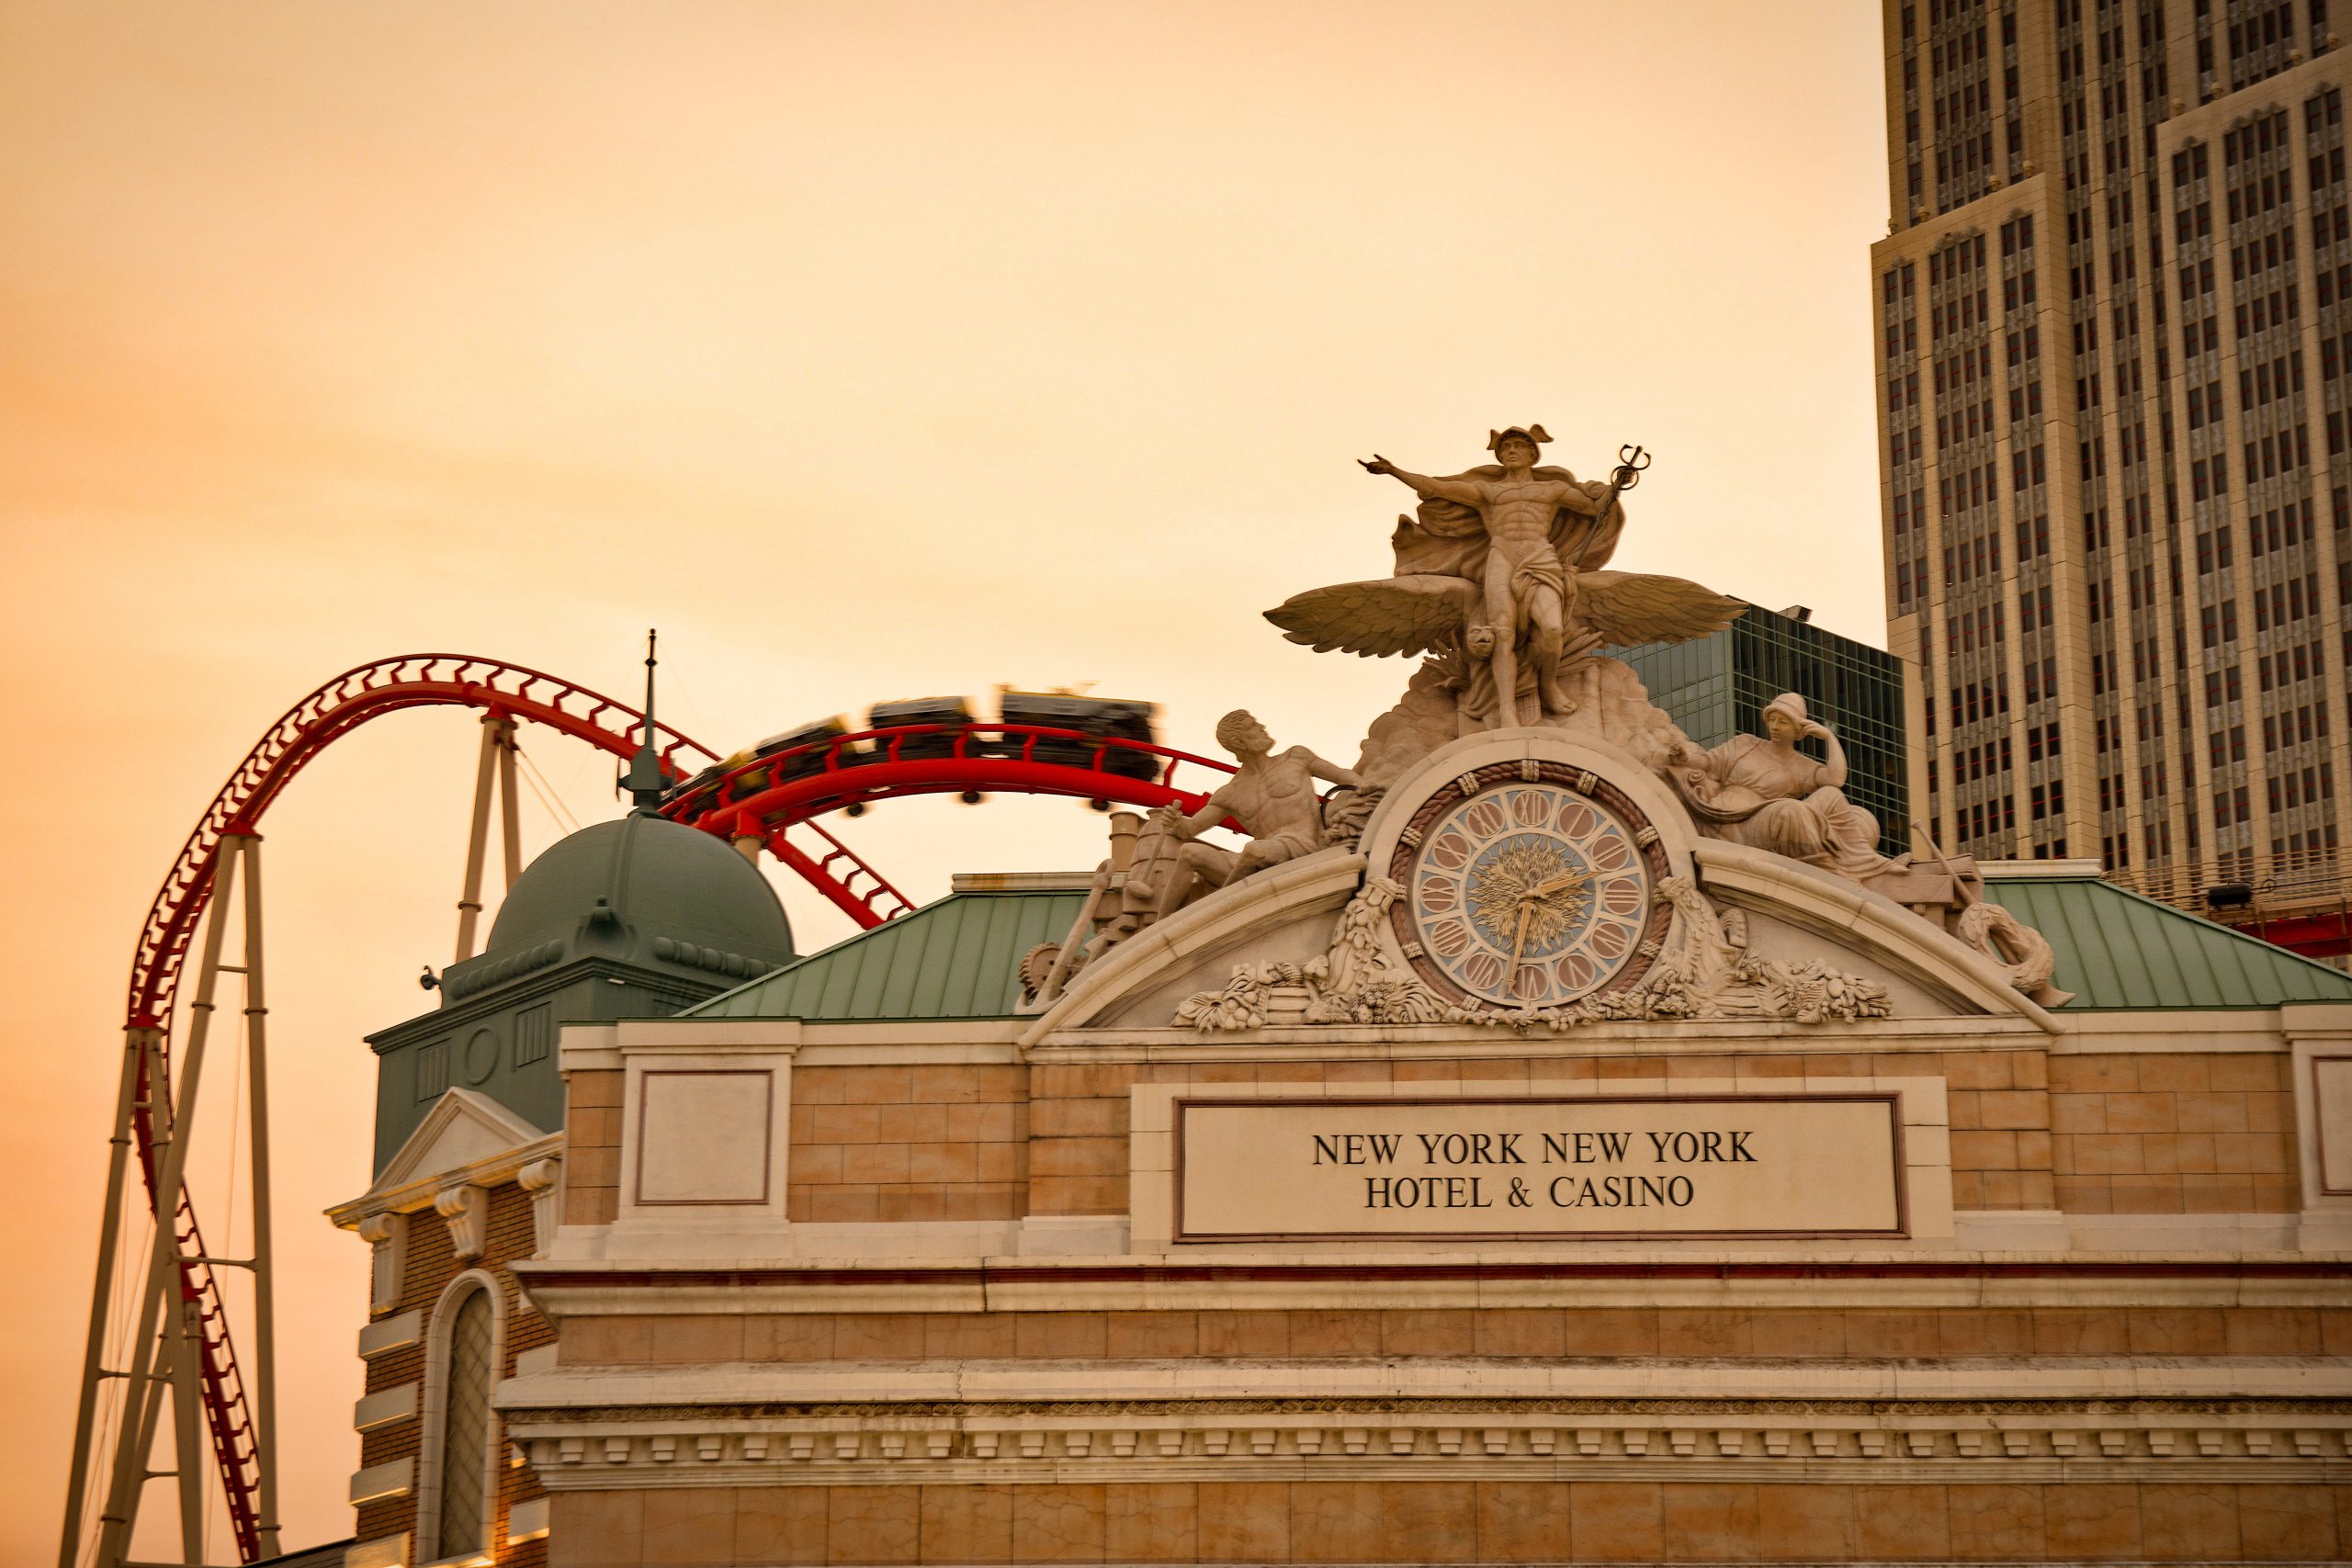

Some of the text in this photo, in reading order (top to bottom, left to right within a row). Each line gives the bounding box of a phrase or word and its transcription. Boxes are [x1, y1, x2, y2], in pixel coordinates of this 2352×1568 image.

[1312, 1131, 1758, 1166] NEW YORK NEW YORK
[1363, 1175, 1694, 1209] HOTEL & CASINO
